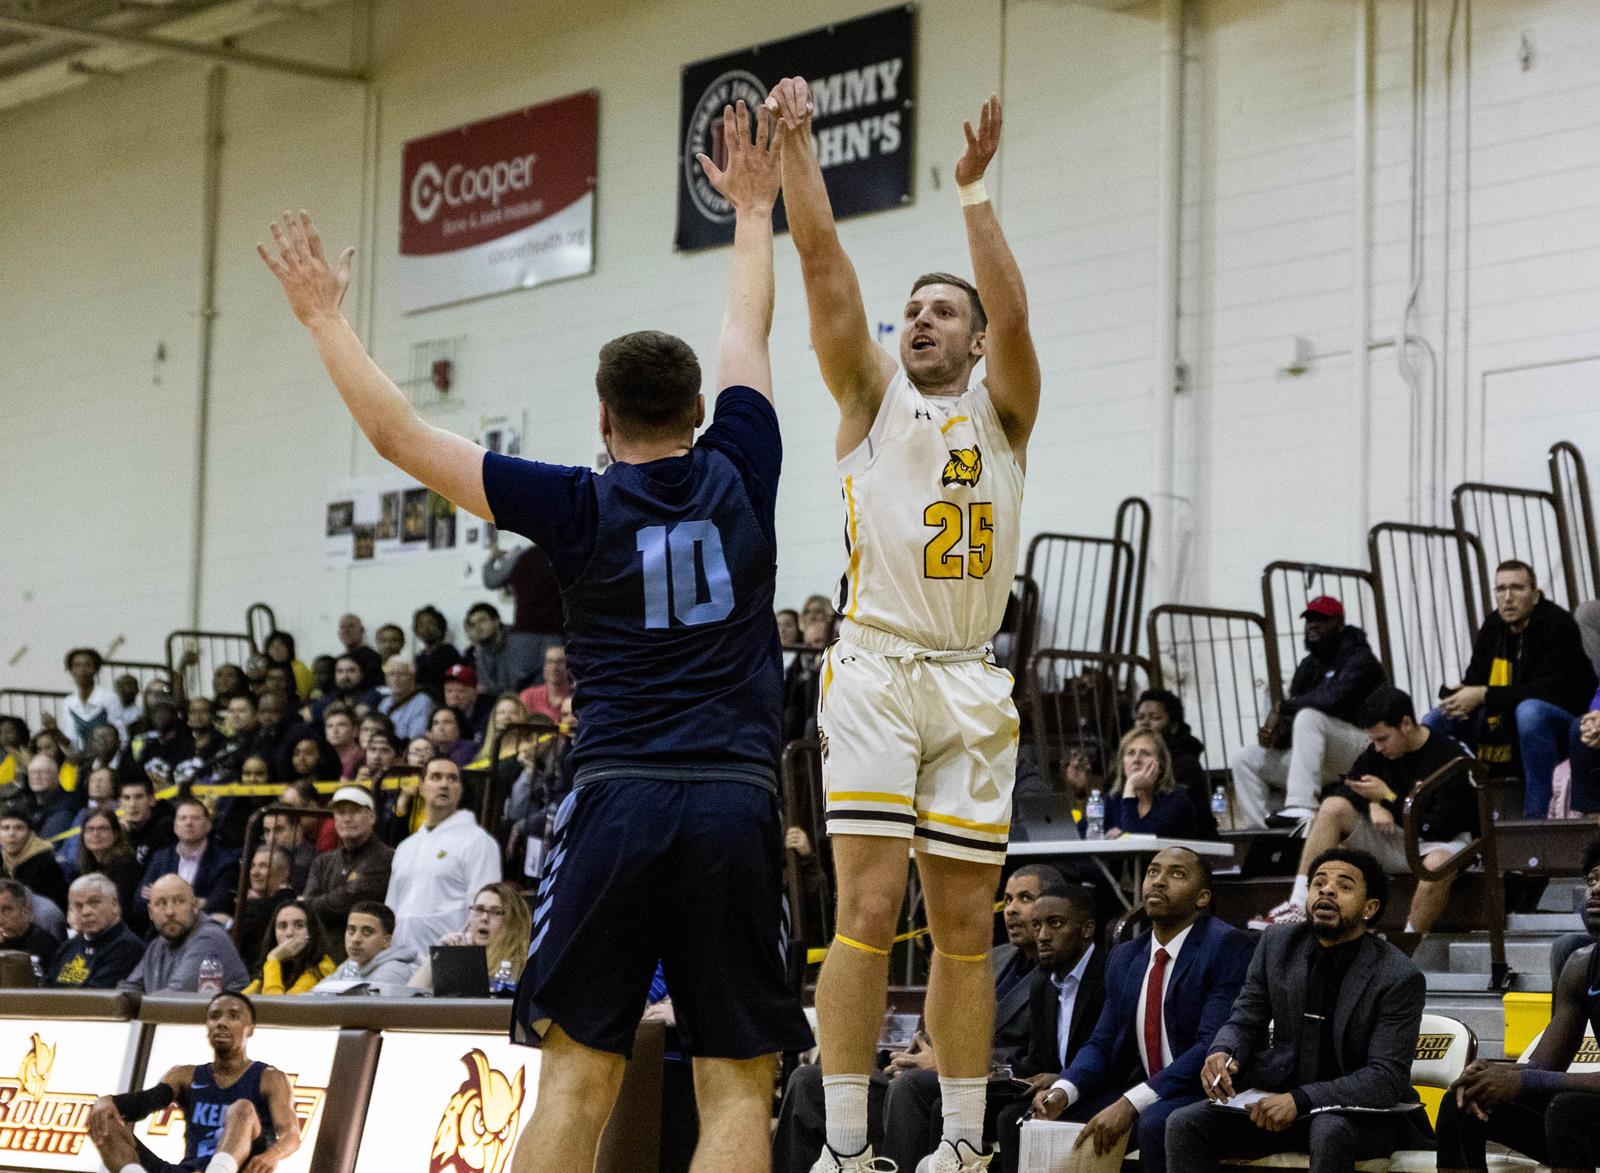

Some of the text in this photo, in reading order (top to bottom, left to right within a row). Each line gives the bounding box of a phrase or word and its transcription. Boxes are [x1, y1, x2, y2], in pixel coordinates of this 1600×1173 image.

[808, 57, 903, 119] MMY
[810, 111, 902, 168] HN'S
[443, 153, 537, 206] Cooper
[923, 501, 994, 579] 25
[636, 519, 735, 628] 10
